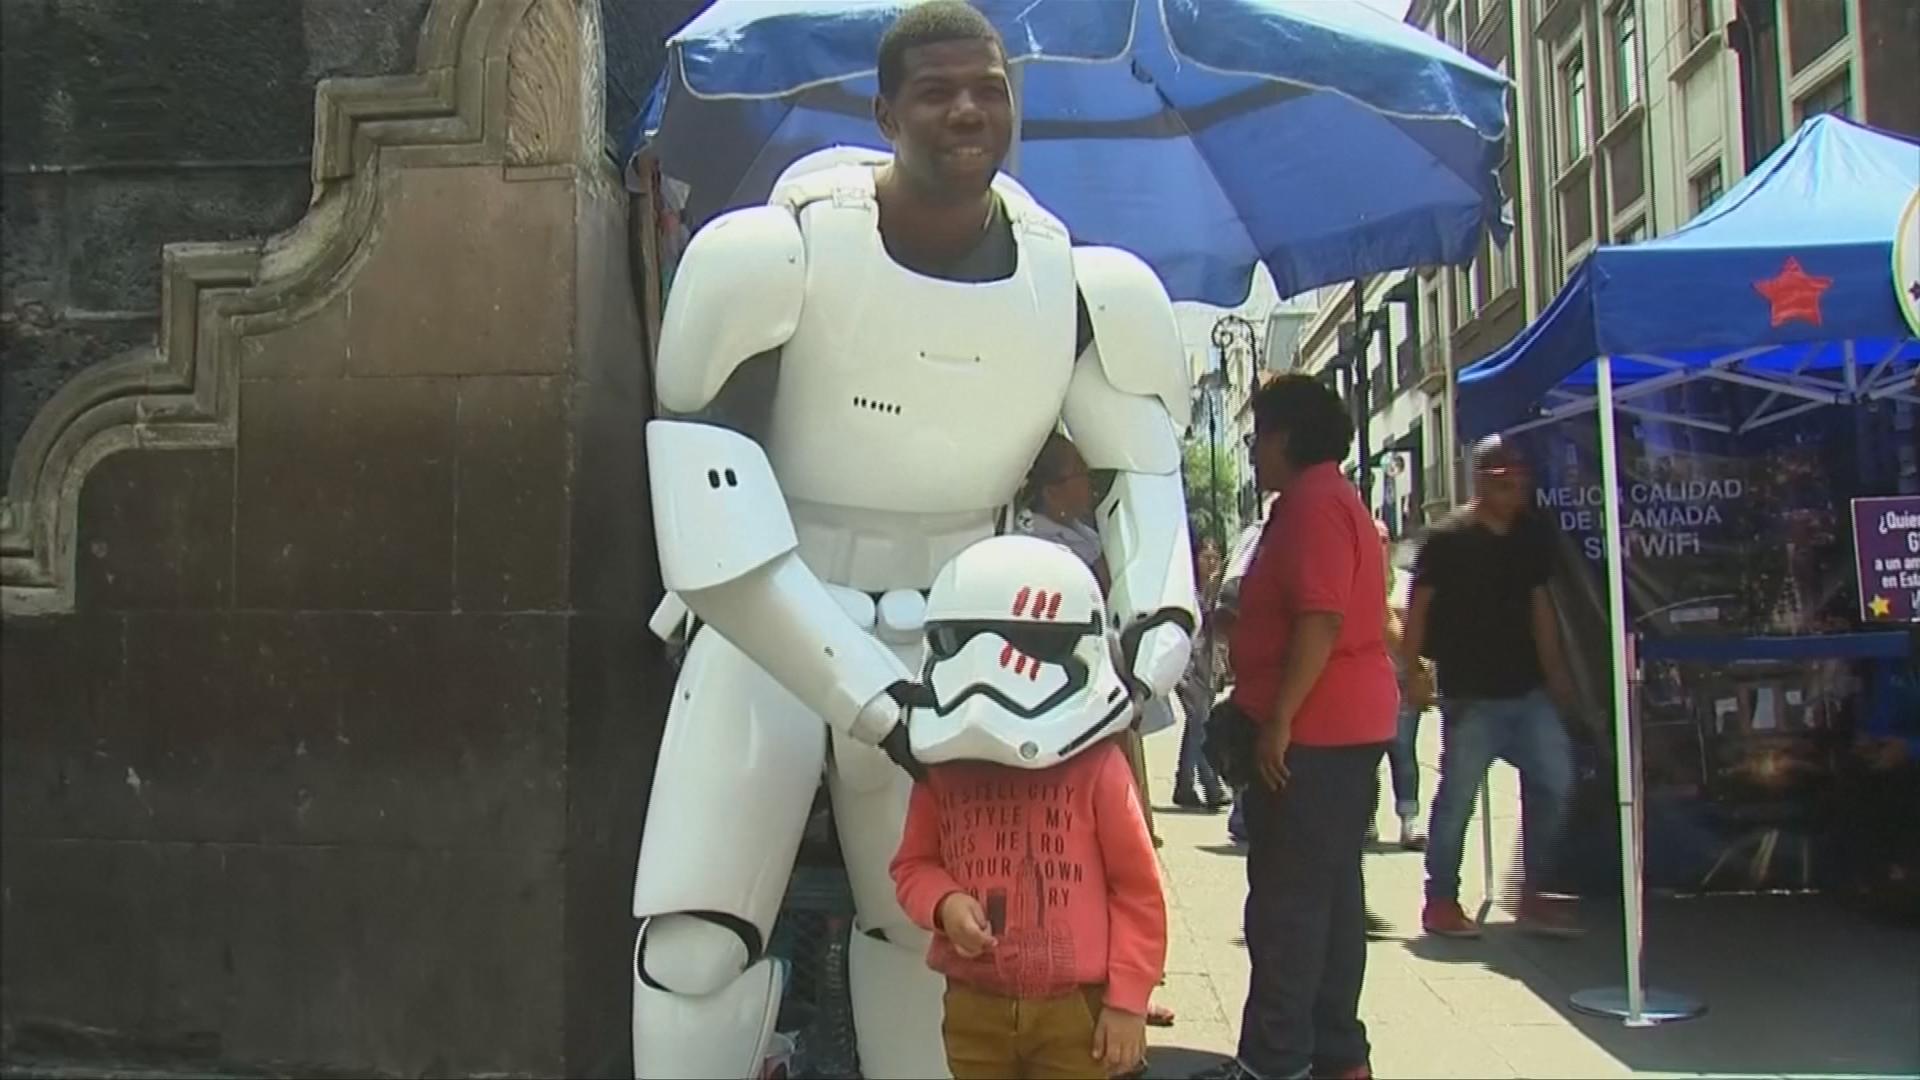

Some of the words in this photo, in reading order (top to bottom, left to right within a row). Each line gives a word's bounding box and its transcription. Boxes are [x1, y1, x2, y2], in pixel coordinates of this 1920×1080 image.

[1536, 487, 1623, 507] MEJO
[1631, 479, 1742, 502] CALIDAD
[1560, 512, 1592, 530] DE
[1640, 532, 1700, 557] WiFi
[1885, 558, 1902, 571] un
[1882, 575, 1898, 589] en
[1028, 784, 1074, 804] CITY
[963, 806, 1022, 830] STYLE
[1045, 807, 1073, 832] MY
[965, 856, 1012, 881] YOUR
[1044, 859, 1083, 883] OWN
